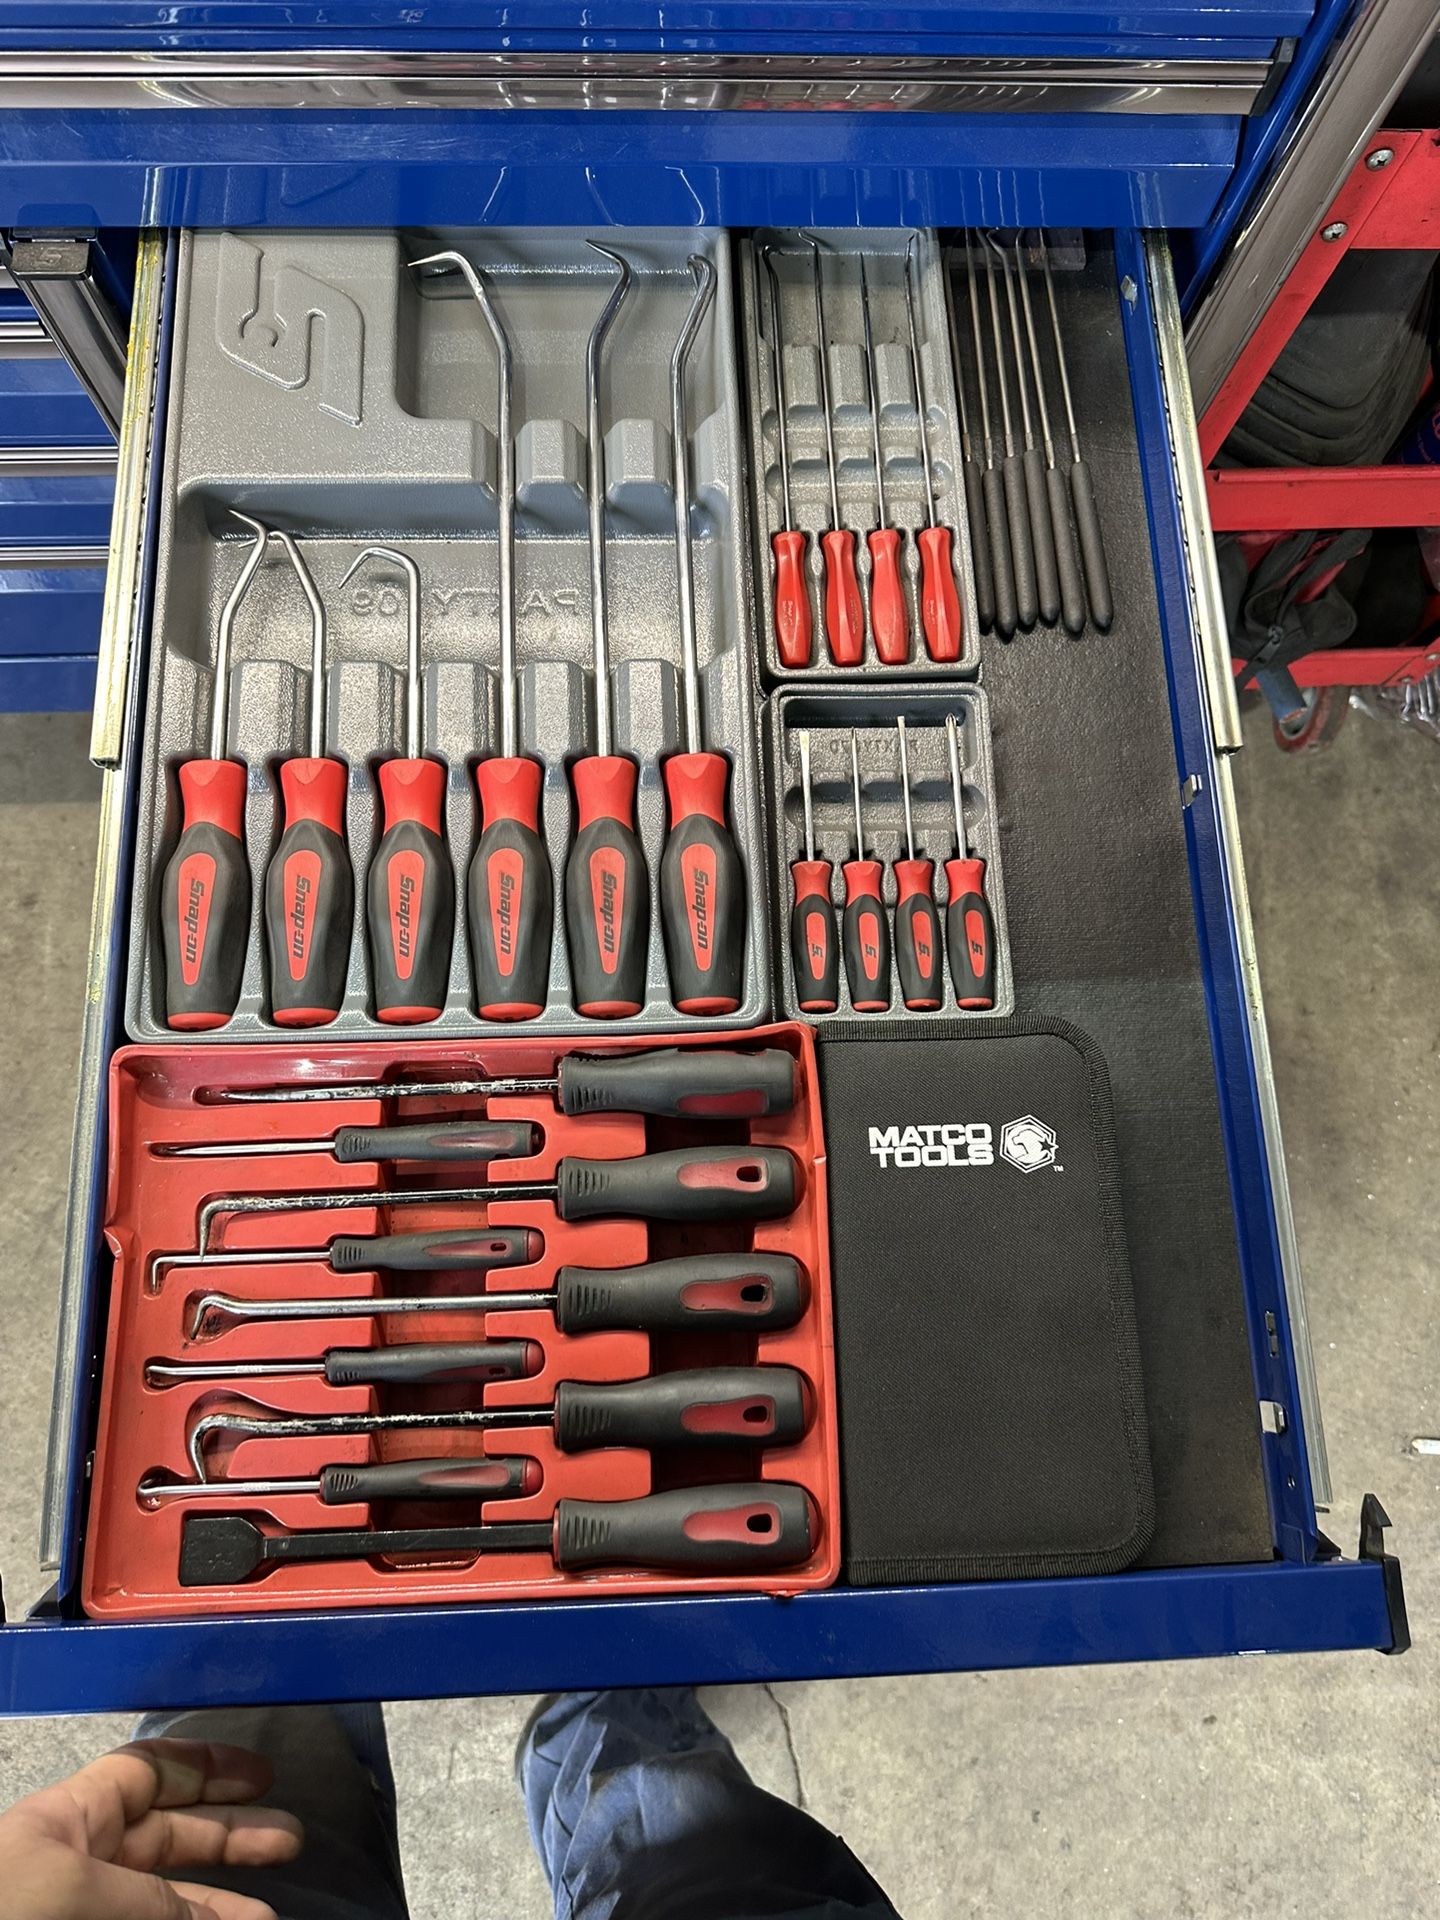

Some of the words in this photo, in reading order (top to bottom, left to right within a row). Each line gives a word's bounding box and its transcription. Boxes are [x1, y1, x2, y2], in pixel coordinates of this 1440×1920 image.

[184, 878, 206, 963] Snap-on
[290, 875, 311, 959] Snap-on
[396, 874, 415, 958] Snap-on
[497, 870, 516, 954] Snap-on
[600, 869, 618, 953] Snap-on
[692, 867, 709, 950] Snap-on
[868, 1123, 993, 1148] MATCO
[870, 1144, 995, 1168] TOOLS
